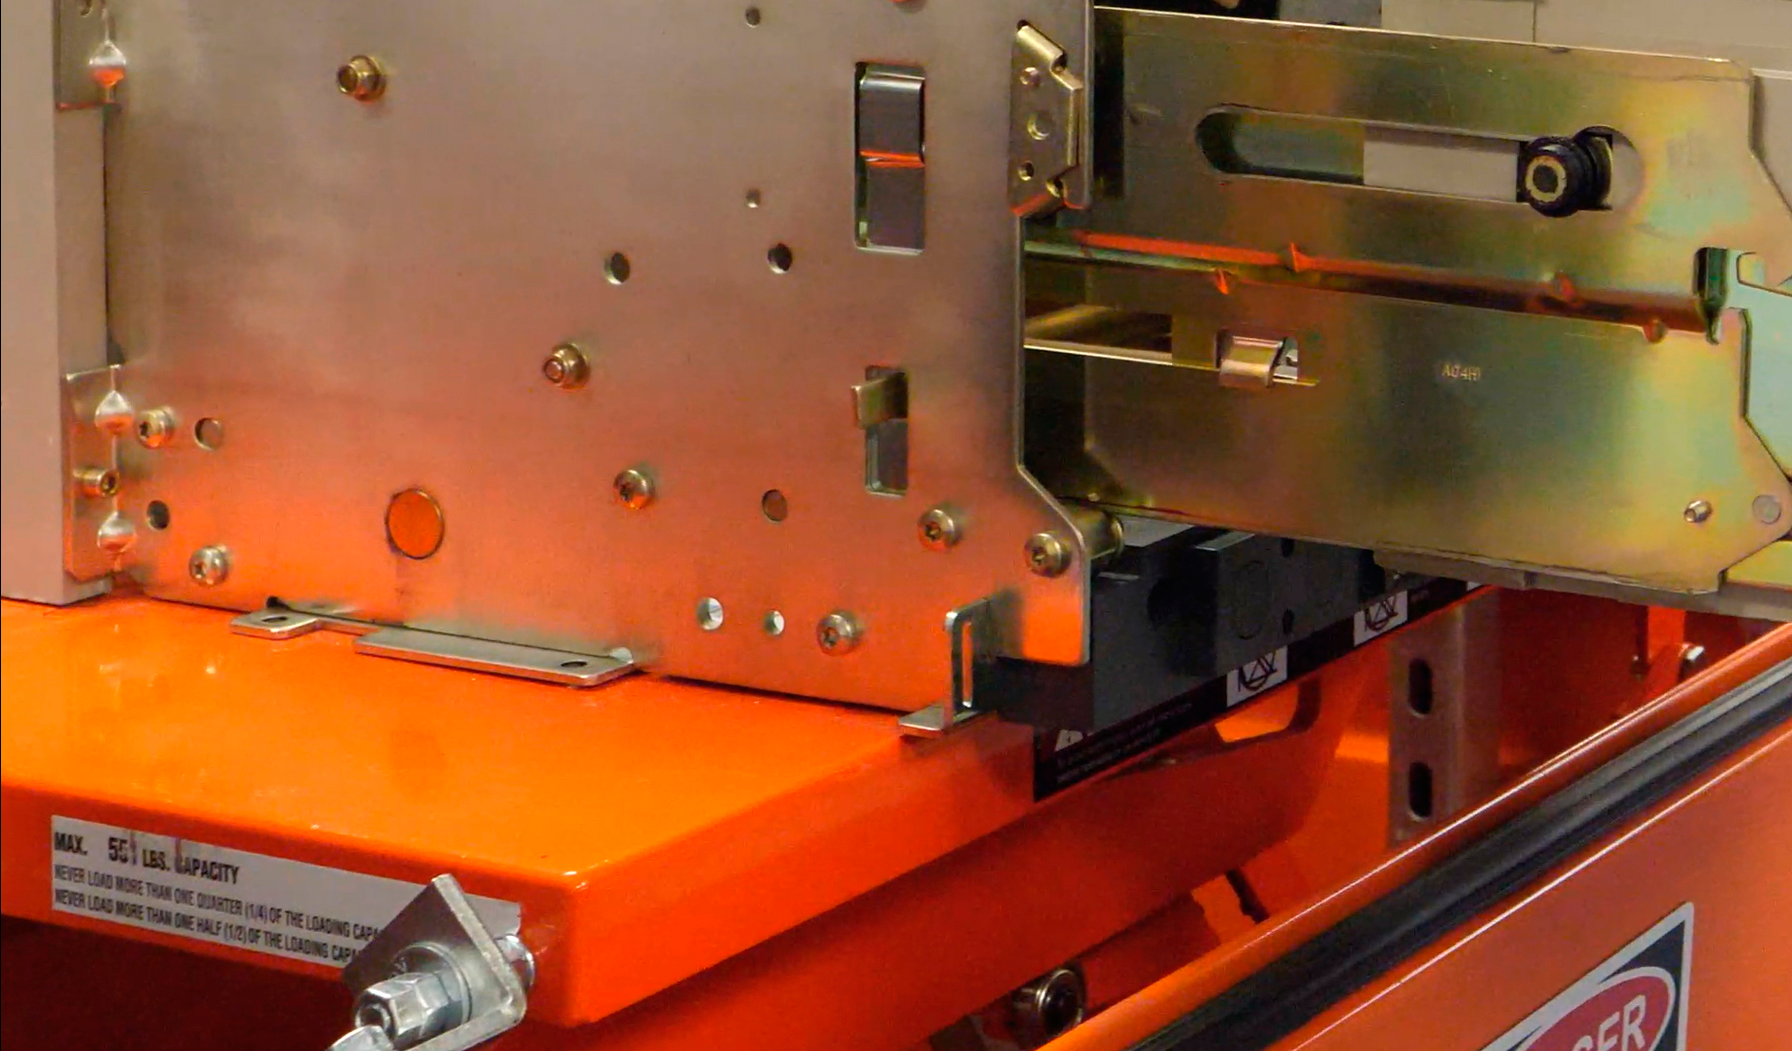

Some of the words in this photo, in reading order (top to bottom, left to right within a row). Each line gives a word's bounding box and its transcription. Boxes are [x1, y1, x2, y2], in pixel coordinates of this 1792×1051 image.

[54, 831, 88, 856] MAX.
[142, 849, 170, 871] LBS.
[54, 864, 85, 883] NEVER
[88, 870, 113, 890] LOAD
[115, 876, 143, 896] MORE
[146, 881, 172, 900] THAN
[174, 888, 194, 905] ONE
[196, 892, 243, 917] QUARTER
[245, 901, 268, 924] (1/4)
[269, 907, 282, 924] OF
[285, 910, 303, 929] THE
[306, 915, 350, 938] LOADING
[55, 888, 86, 908] NEVER
[88, 895, 114, 913] LOAD
[115, 900, 143, 920] MORE
[146, 906, 172, 926] THAN
[174, 912, 194, 930] ONE
[197, 917, 221, 936] HALF
[248, 928, 261, 944] OF
[264, 930, 282, 949] THE
[285, 934, 328, 958] LOADING
